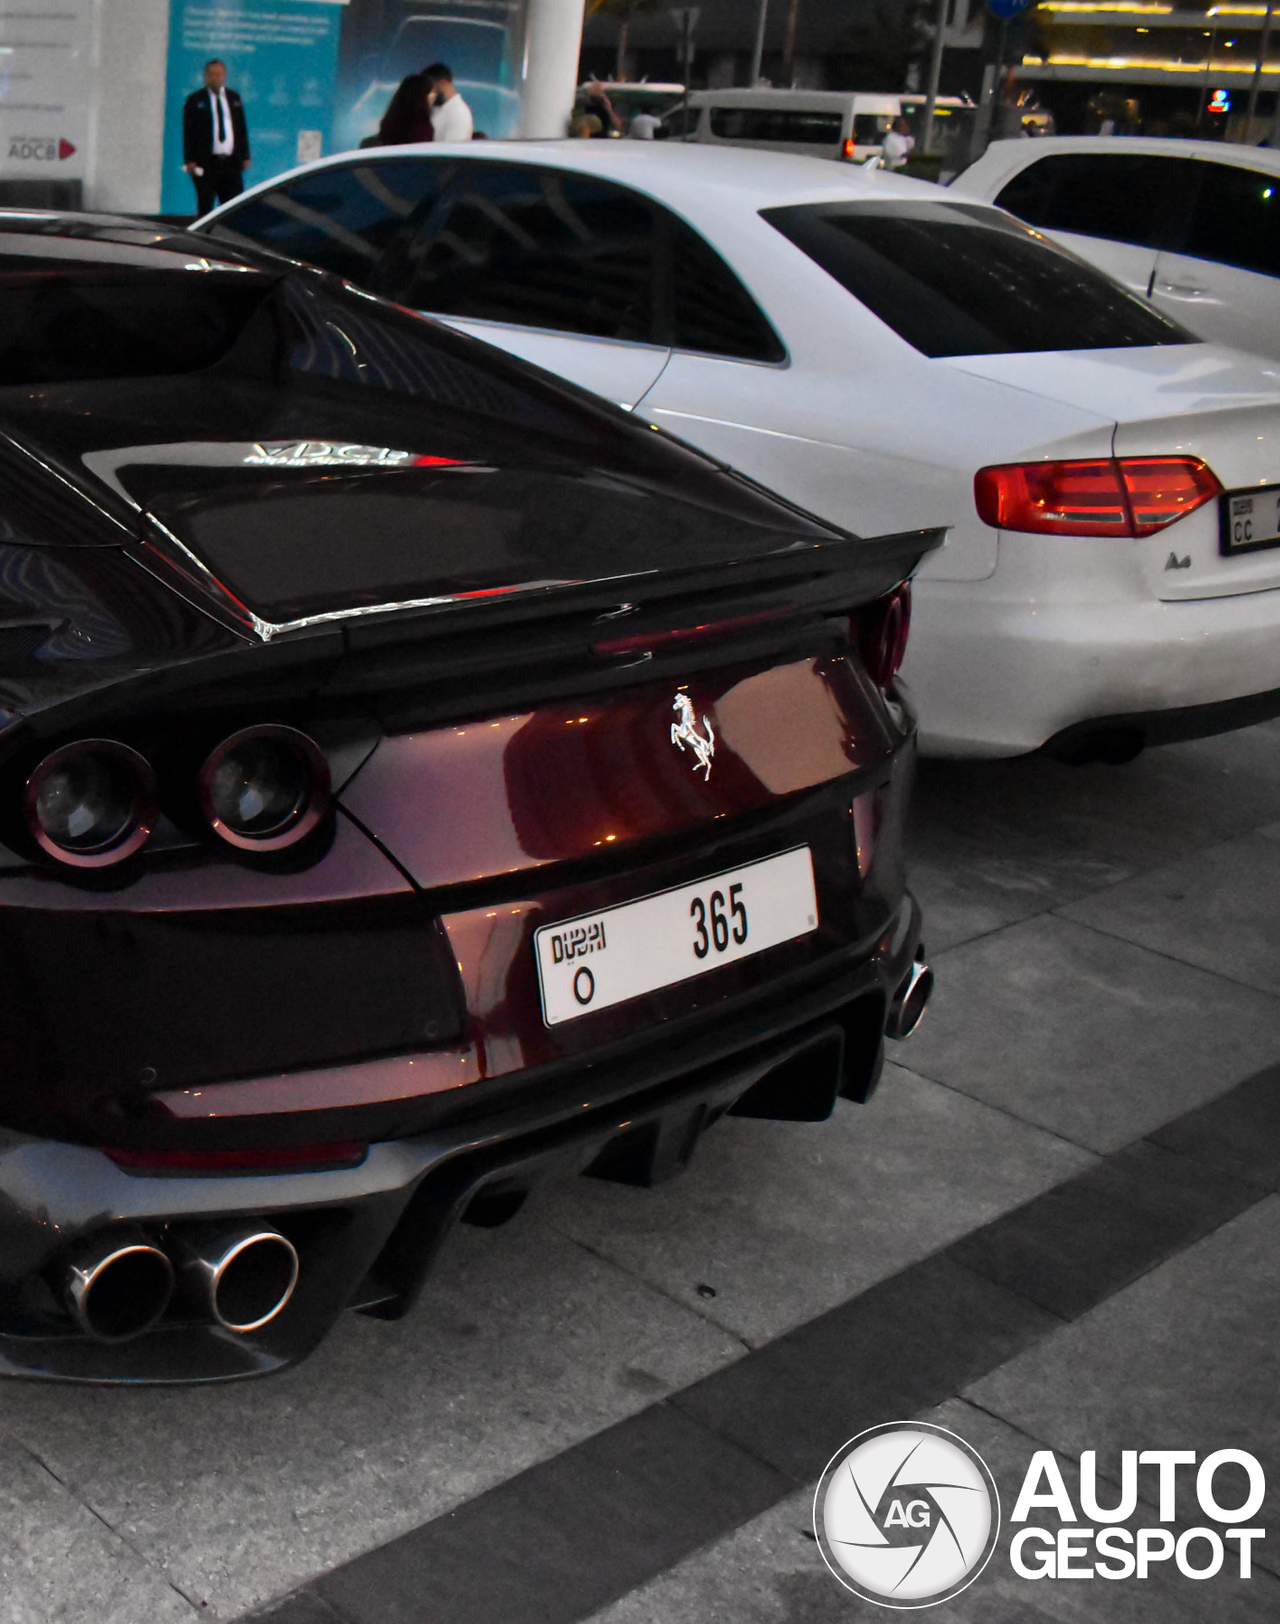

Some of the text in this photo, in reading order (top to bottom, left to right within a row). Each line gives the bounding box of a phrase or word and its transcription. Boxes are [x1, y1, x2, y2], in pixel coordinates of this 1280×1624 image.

[8, 144, 56, 161] ADCB
[1233, 519, 1253, 543] CC
[690, 883, 748, 959] 365
